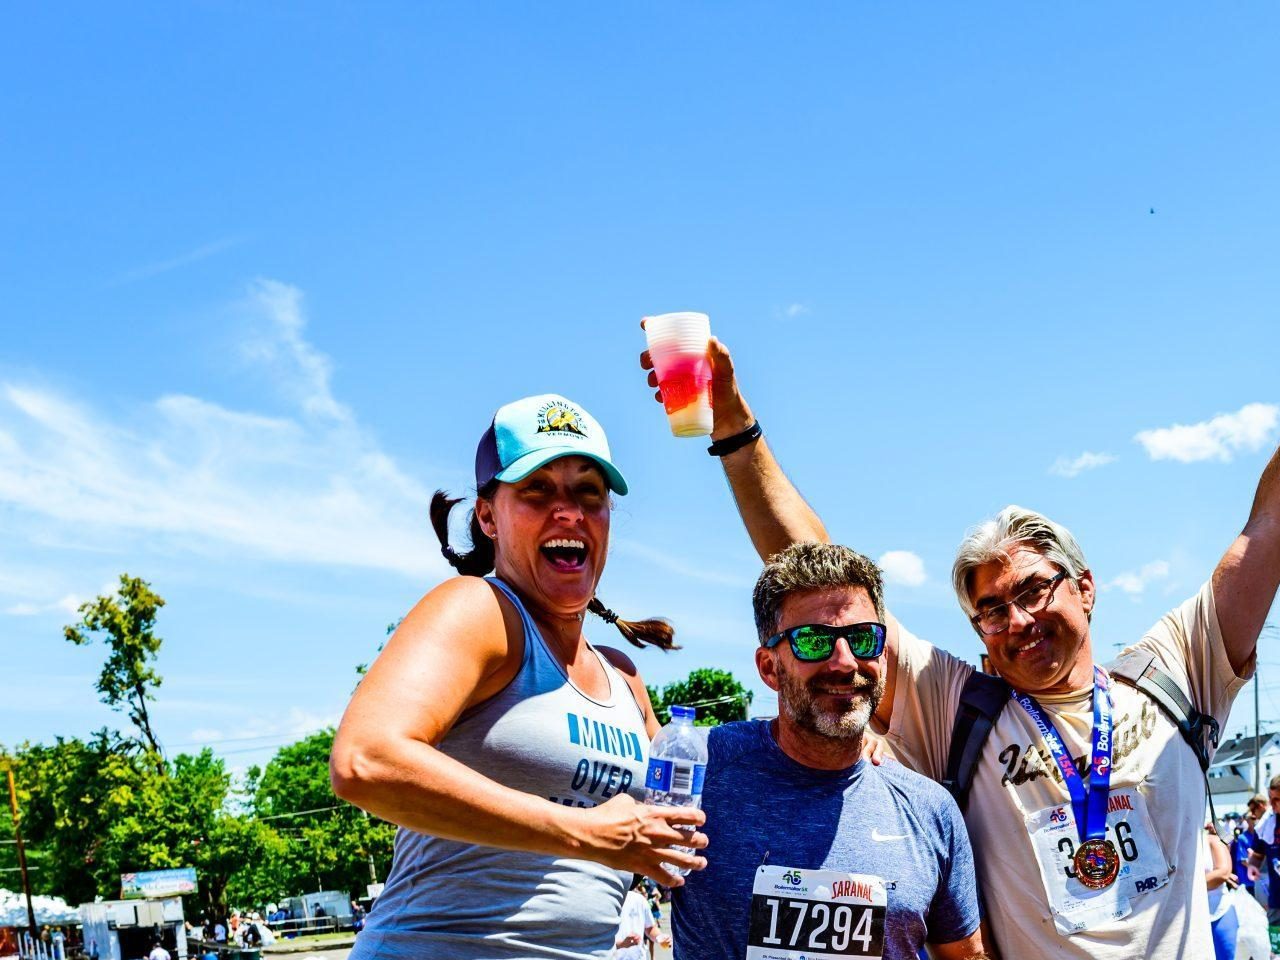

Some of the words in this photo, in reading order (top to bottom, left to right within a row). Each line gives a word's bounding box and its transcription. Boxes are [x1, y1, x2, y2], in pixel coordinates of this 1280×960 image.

[537, 401, 582, 421] KILLINGTON
[546, 432, 584, 440] VERMONT
[1020, 698, 1063, 755] Boilermaker
[1056, 754, 1076, 777] 15K
[571, 758, 633, 798] OVER
[831, 881, 873, 903] SARANAC
[1135, 876, 1158, 892] PAR
[762, 898, 873, 952] 17294
